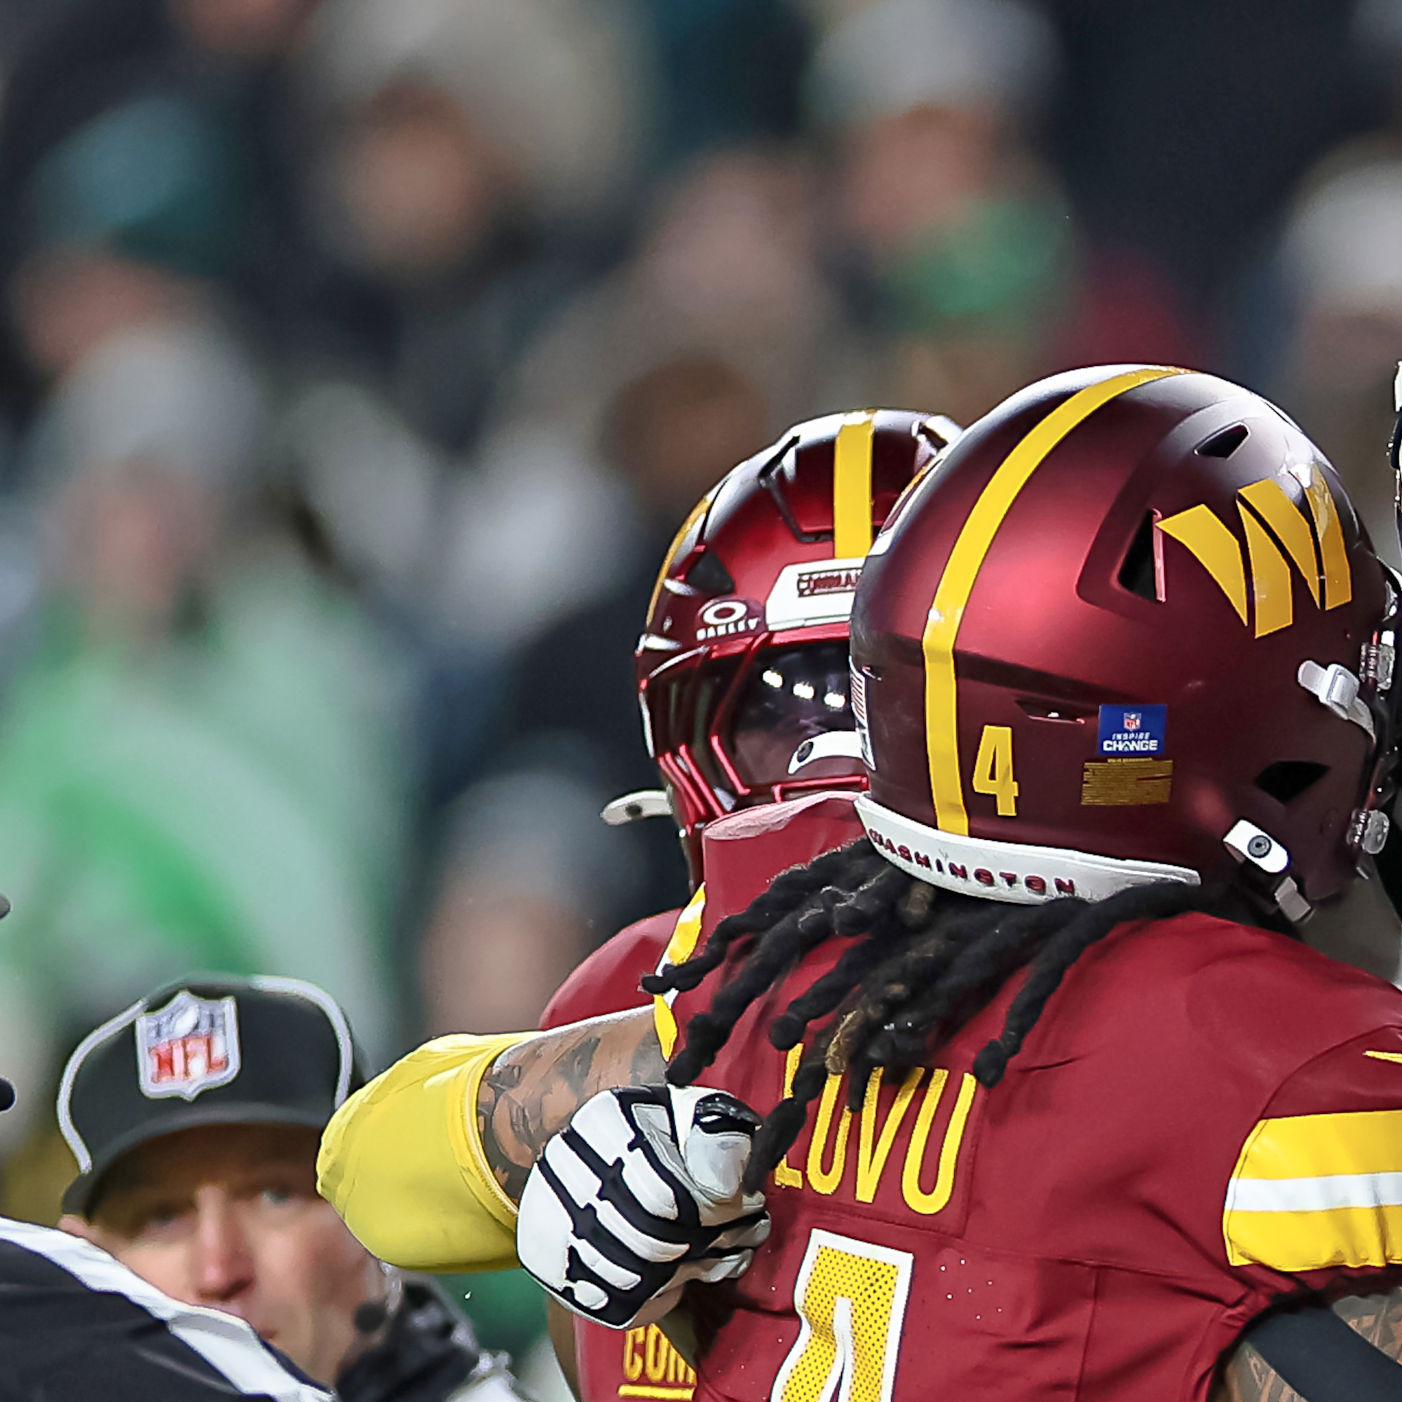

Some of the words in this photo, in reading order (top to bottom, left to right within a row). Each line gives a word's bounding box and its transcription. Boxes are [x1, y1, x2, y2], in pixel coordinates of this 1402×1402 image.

[1103, 740, 1158, 751] CHANGE
[1112, 732, 1151, 740] INSPIRE
[972, 725, 1019, 816] 4
[868, 828, 1076, 895] WASHINGTON
[147, 1033, 230, 1084] NFL
